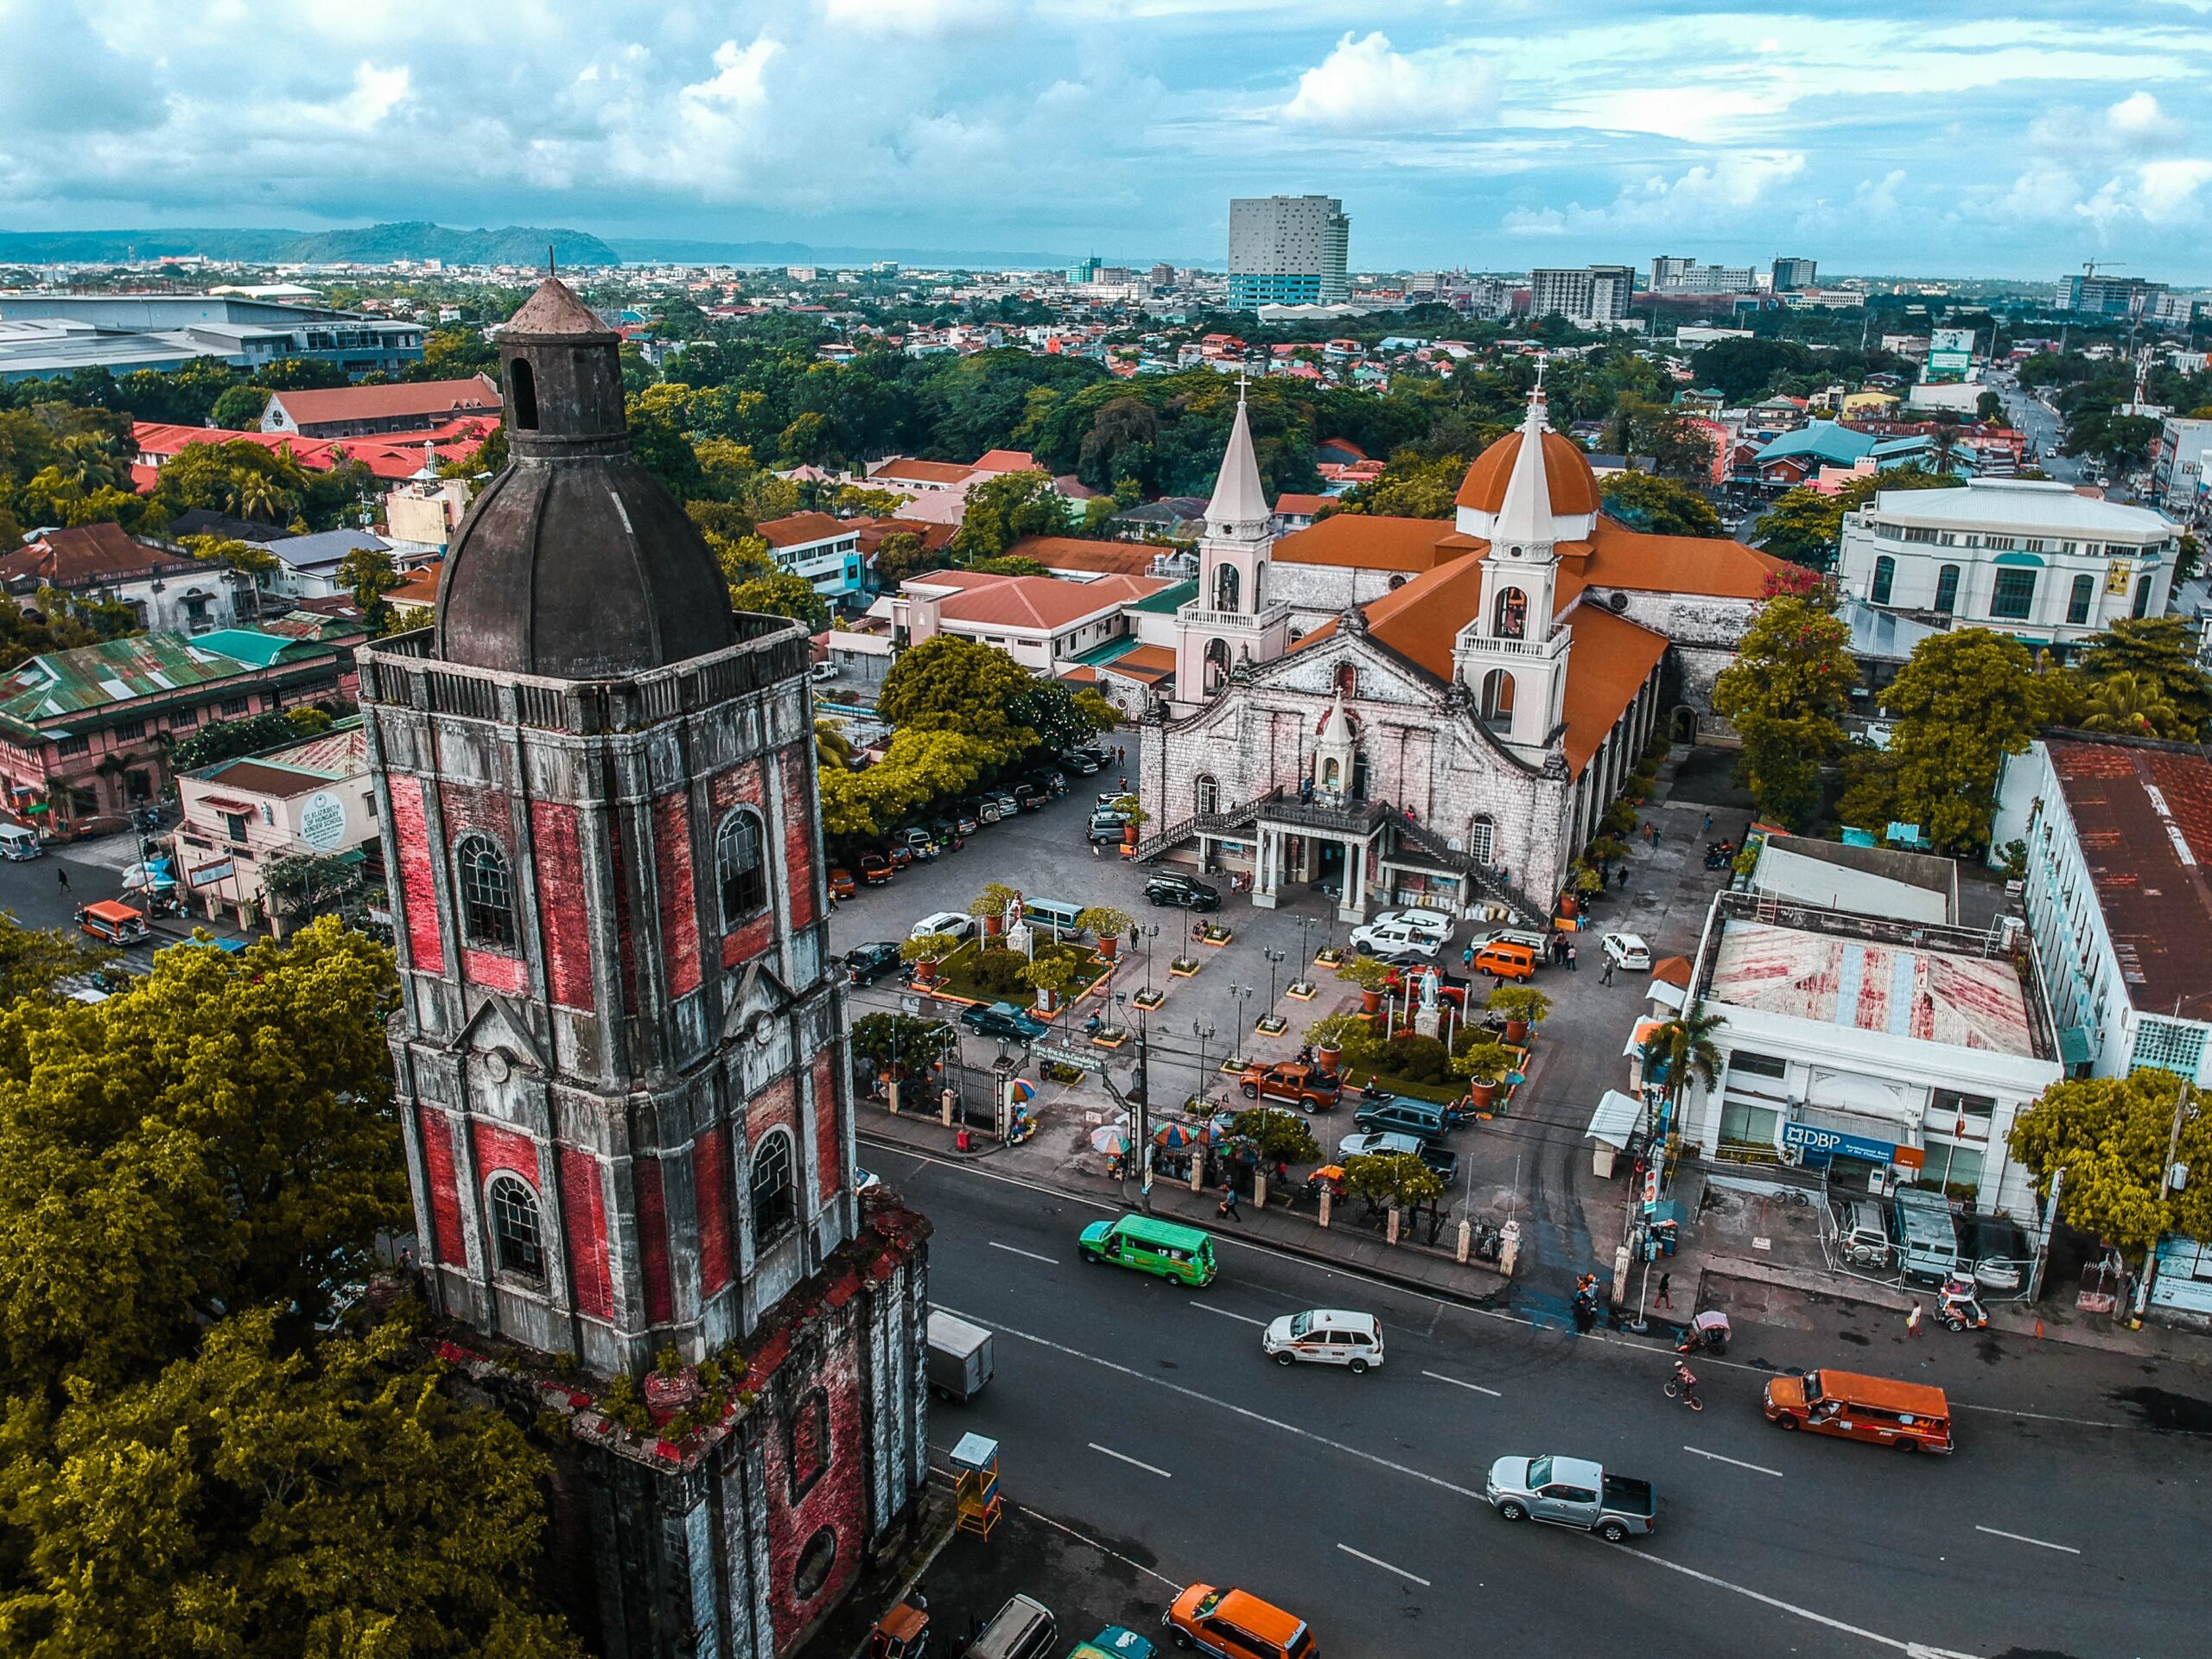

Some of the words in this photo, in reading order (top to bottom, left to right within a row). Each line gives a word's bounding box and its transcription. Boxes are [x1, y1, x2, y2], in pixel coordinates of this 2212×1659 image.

[311, 804, 340, 818] ELIZABETH
[315, 811, 339, 823] HUNGARY
[304, 823, 322, 834] KINDER
[324, 816, 344, 827] SCHOOL
[1803, 1129, 1840, 1149] DBP
[1846, 1144, 1877, 1154] Development
[1863, 1151, 1890, 1160] Philippines
